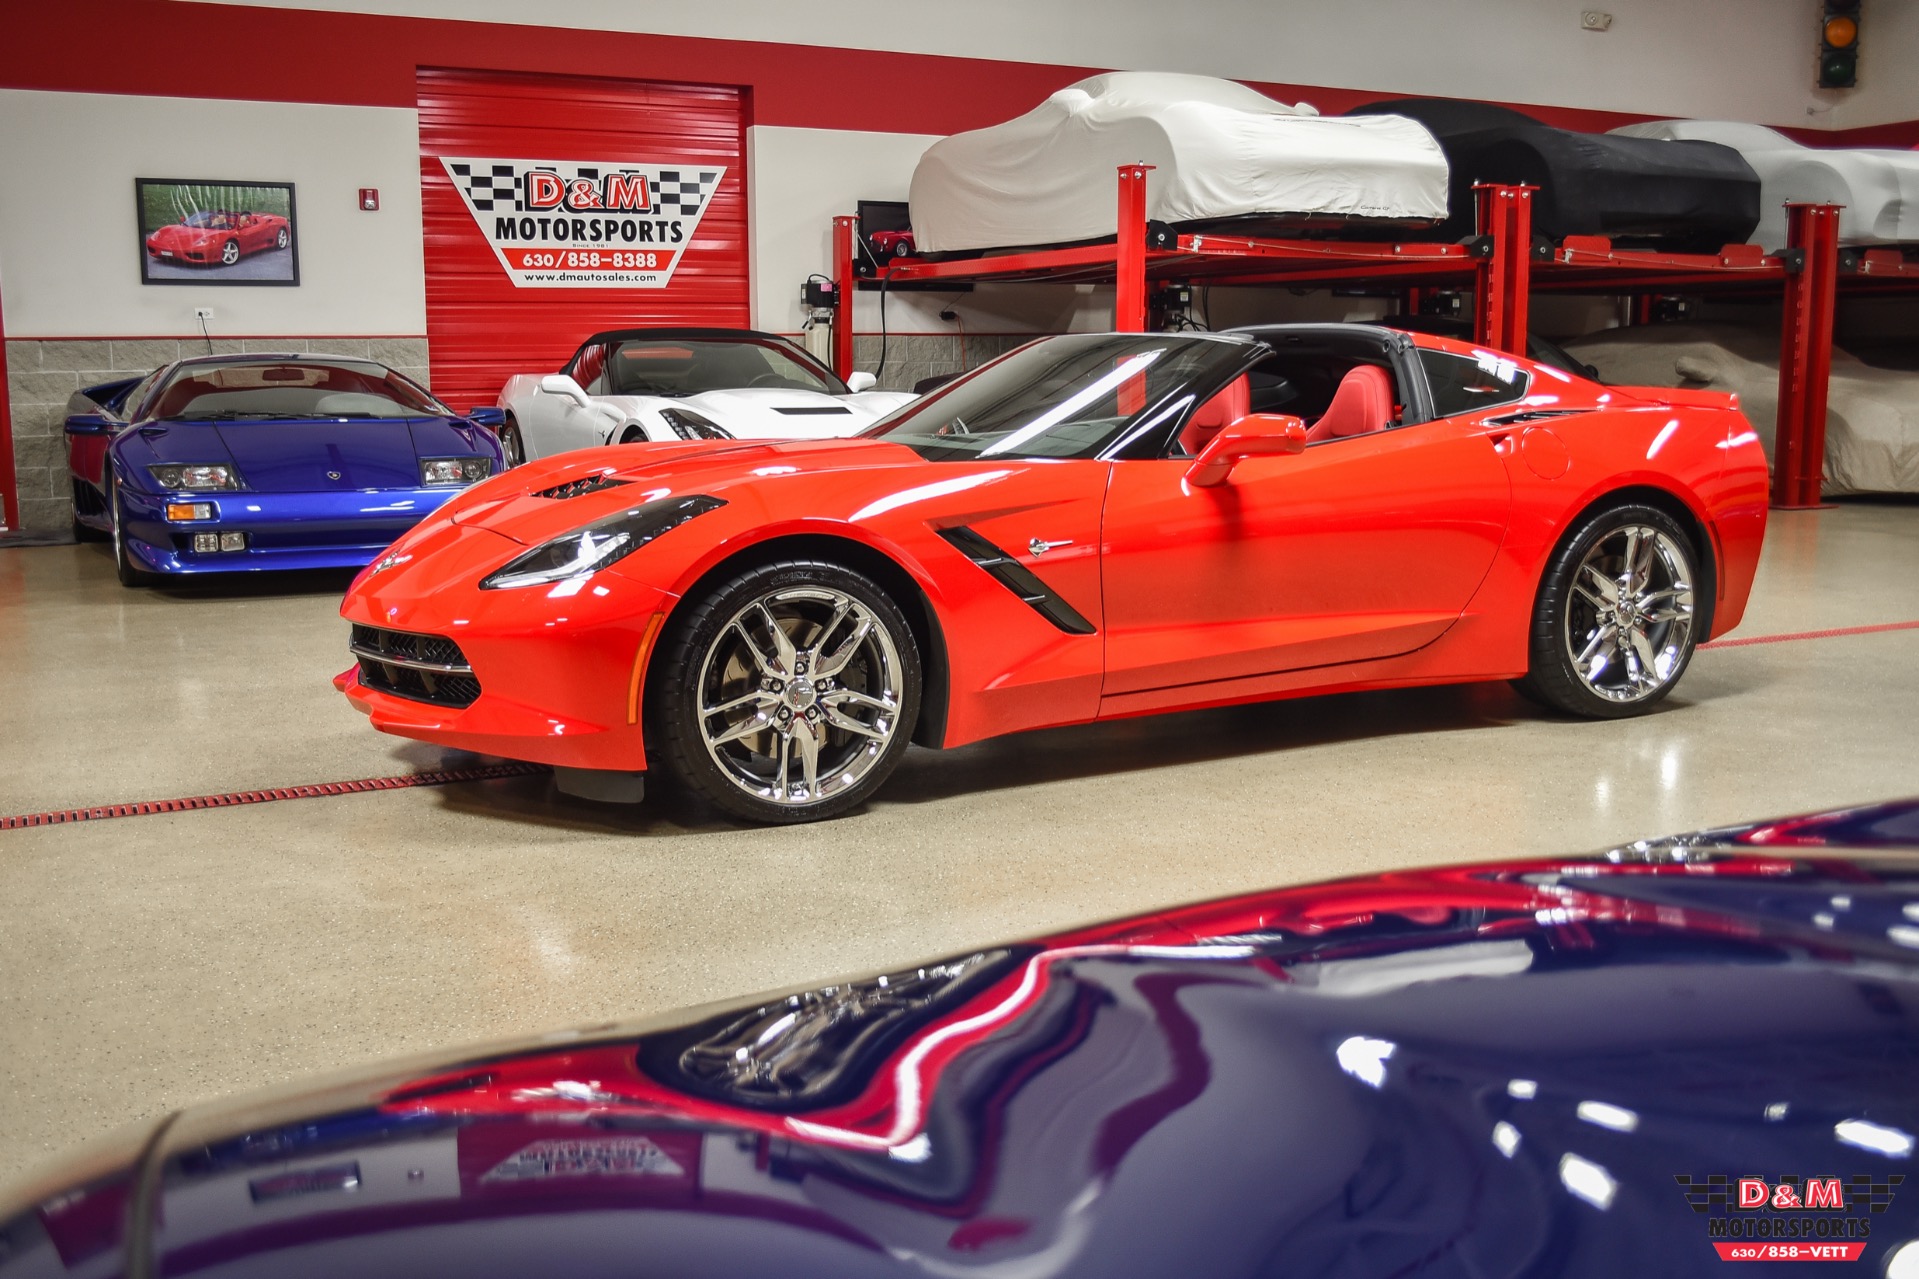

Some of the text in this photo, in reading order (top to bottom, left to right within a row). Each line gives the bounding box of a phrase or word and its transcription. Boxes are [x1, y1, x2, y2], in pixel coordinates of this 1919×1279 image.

[526, 170, 652, 212] D&M
[495, 217, 683, 243] MOTORSPORTS
[522, 251, 657, 268] 630/858-8388
[525, 272, 657, 282] www.dmautosales.com
